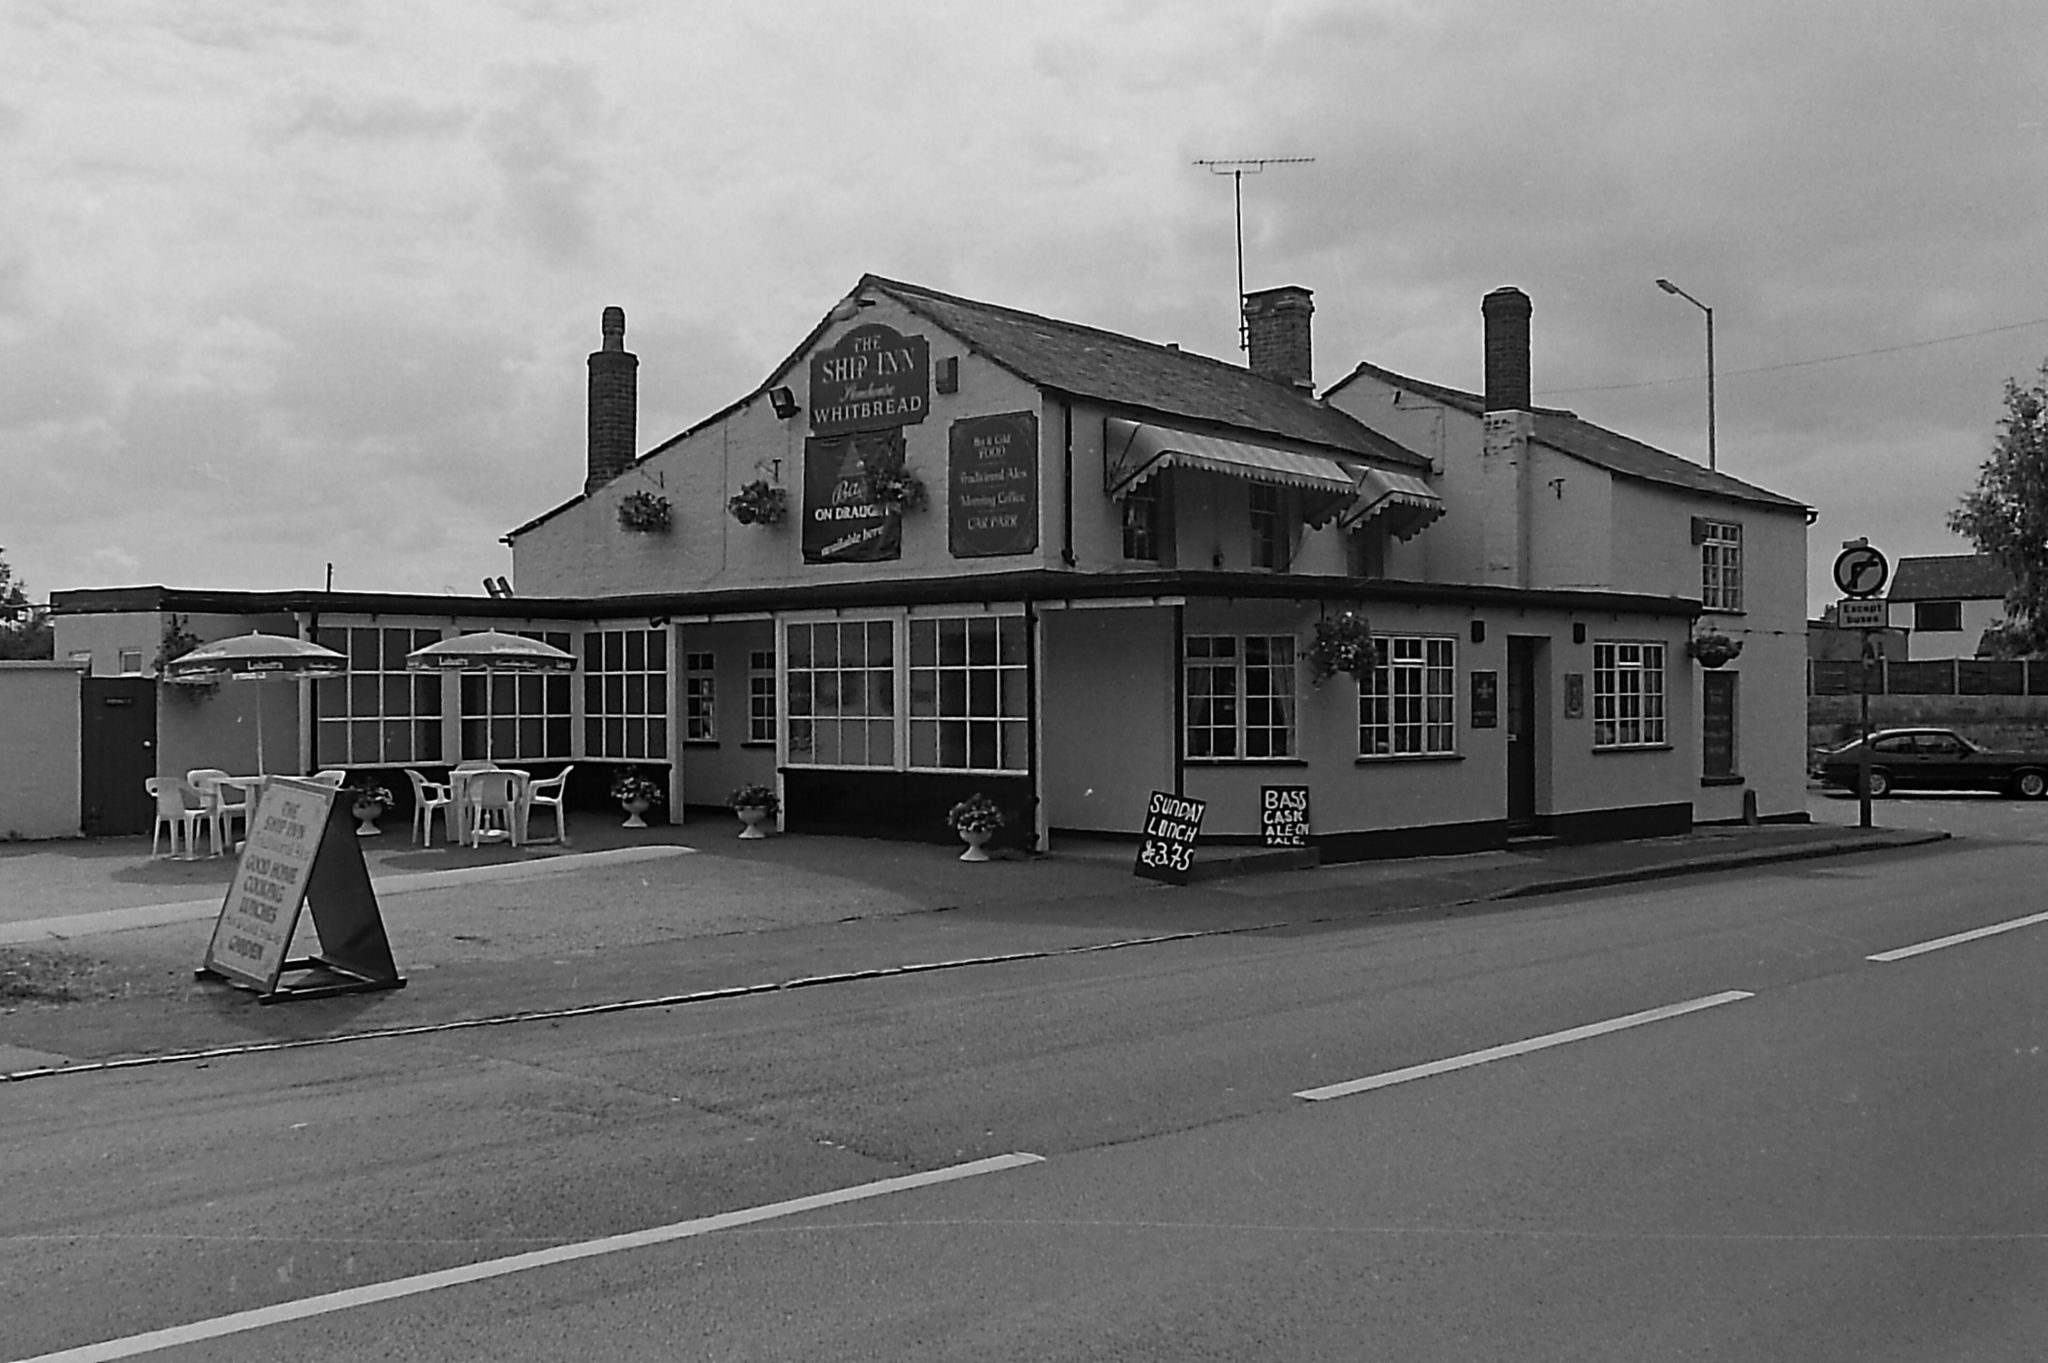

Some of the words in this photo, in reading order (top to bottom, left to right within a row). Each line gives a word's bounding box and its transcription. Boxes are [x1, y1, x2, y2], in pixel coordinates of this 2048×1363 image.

[855, 335, 881, 352] THE
[822, 355, 868, 384] SHIP
[878, 347, 915, 375] INN
[813, 395, 922, 423] WHITBREAD
[815, 508, 833, 521] ON
[835, 504, 889, 520] DRAUGT
[1843, 604, 1882, 613] Except
[1150, 794, 1205, 823] SUNDAY
[1265, 790, 1307, 811] BASS
[1263, 810, 1303, 825] CASK
[1147, 816, 1197, 843] LUNCH
[244, 854, 272, 876] GOOD
[1141, 840, 1194, 871] £3.75
